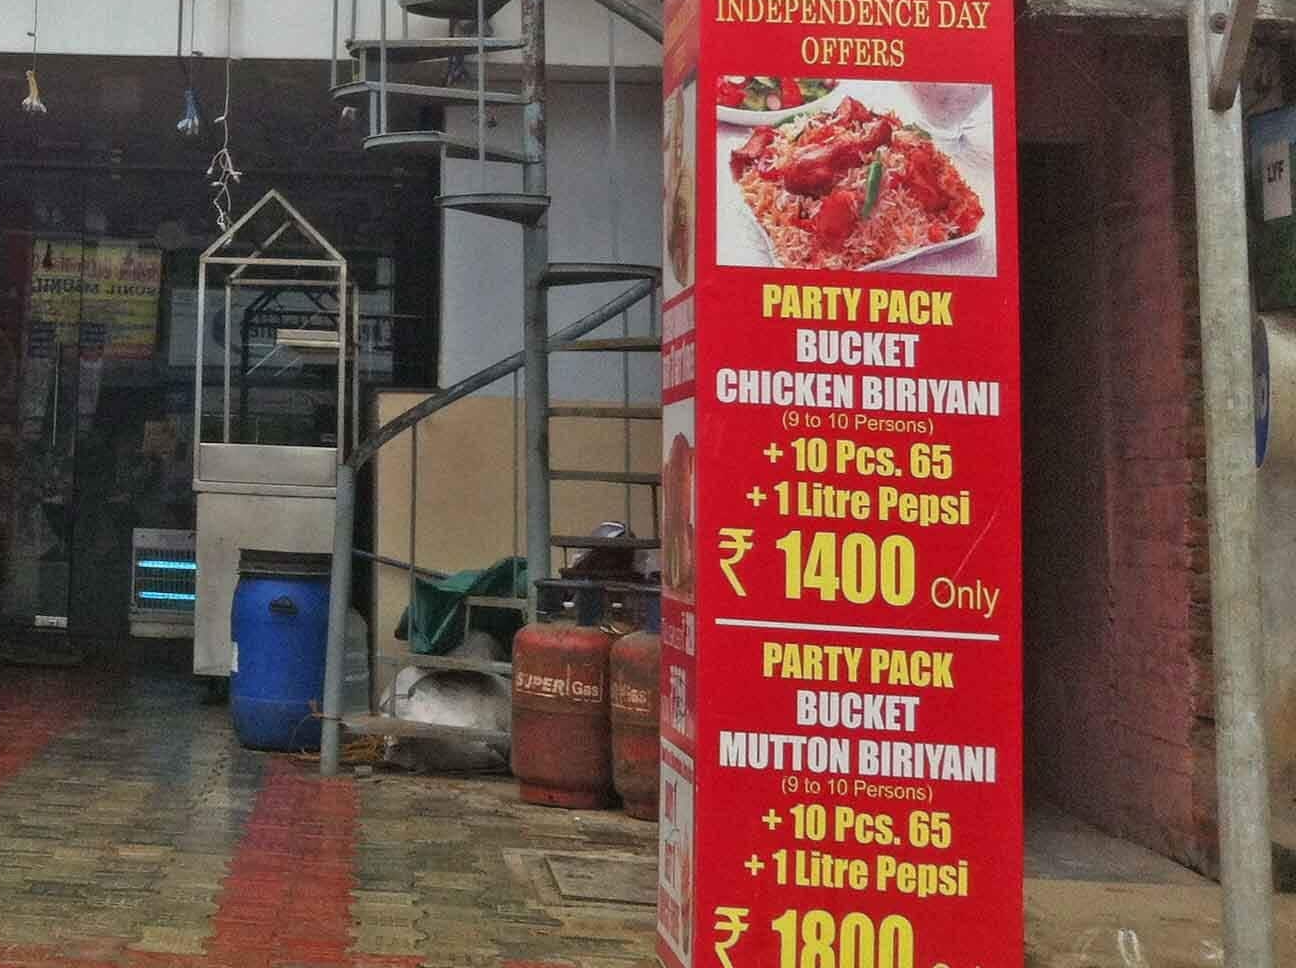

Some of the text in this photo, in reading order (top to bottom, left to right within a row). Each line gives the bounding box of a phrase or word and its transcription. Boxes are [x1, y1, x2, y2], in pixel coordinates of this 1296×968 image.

[937, 0, 992, 30] DAY
[801, 36, 905, 68] OFFERS
[762, 284, 954, 327] PARTY PACK
[796, 328, 920, 368] BUCKET
[716, 368, 1001, 417] CHICKEN BIRIYANI
[782, 409, 934, 437] (9 to 10 Persons)
[836, 439, 903, 477] Pcs.
[910, 442, 953, 480] 65
[798, 482, 872, 520] Litre
[878, 486, 971, 526] Pepsi
[775, 529, 916, 607] 1400
[931, 576, 1000, 619] Only
[762, 642, 955, 689] PARTY PACK
[572, 681, 600, 697] Gas
[796, 689, 921, 732] BUCKET
[719, 731, 850, 776] MUTTON
[858, 738, 997, 783] BIRIYANI
[781, 774, 933, 804] (9 to 10 Persons)
[835, 806, 901, 846] Pcs.
[909, 810, 952, 849] 65
[795, 850, 869, 891] Litre
[876, 855, 969, 899] Pepsi
